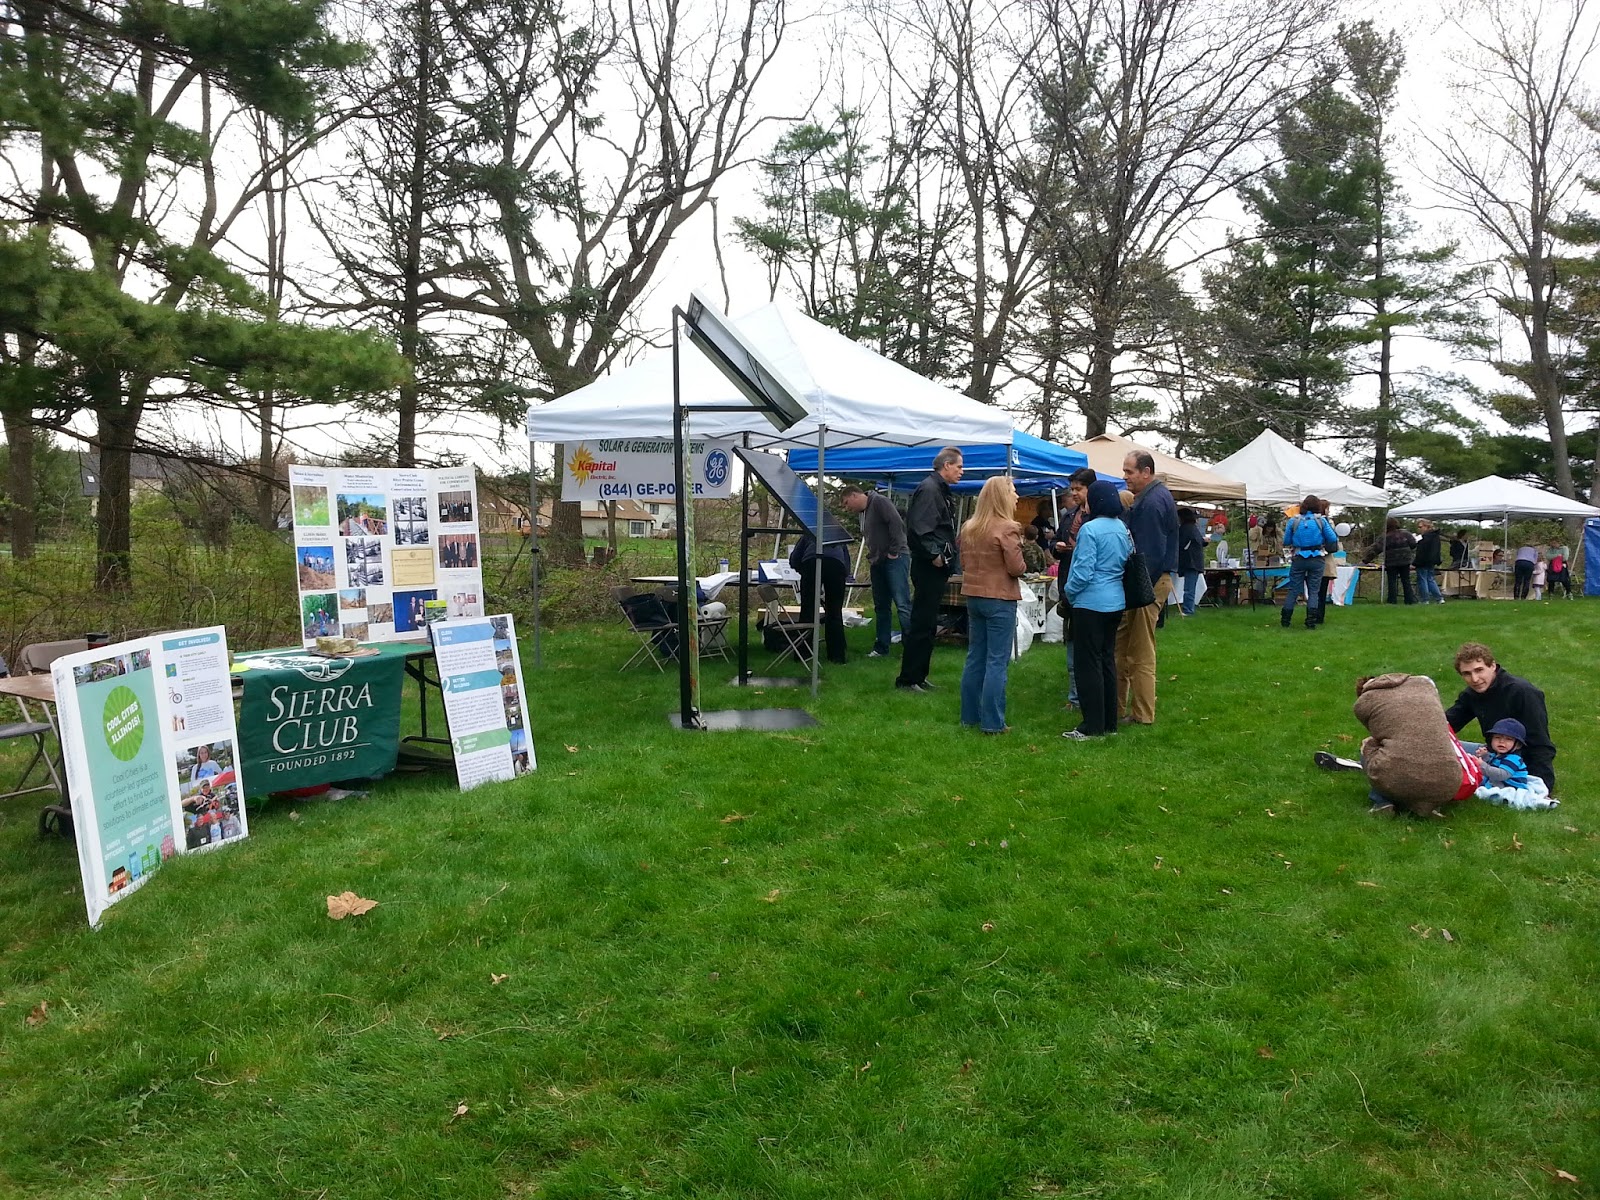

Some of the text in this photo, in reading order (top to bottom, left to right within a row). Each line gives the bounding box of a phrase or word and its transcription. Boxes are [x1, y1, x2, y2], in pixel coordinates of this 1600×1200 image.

[599, 439, 622, 452] SOLAR
[624, 442, 629, 452] &
[631, 441, 674, 454] GENERATOR
[578, 460, 616, 473] Kapital
[599, 483, 704, 499] (844) GE-POR
[188, 636, 211, 645] INVOLVED!
[267, 682, 374, 722] SIERRA
[106, 701, 139, 731] COOL CITIES
[111, 716, 141, 744] ILLINOIS!
[272, 715, 359, 754] CLUB
[270, 750, 356, 773] FOUNDED 1892
